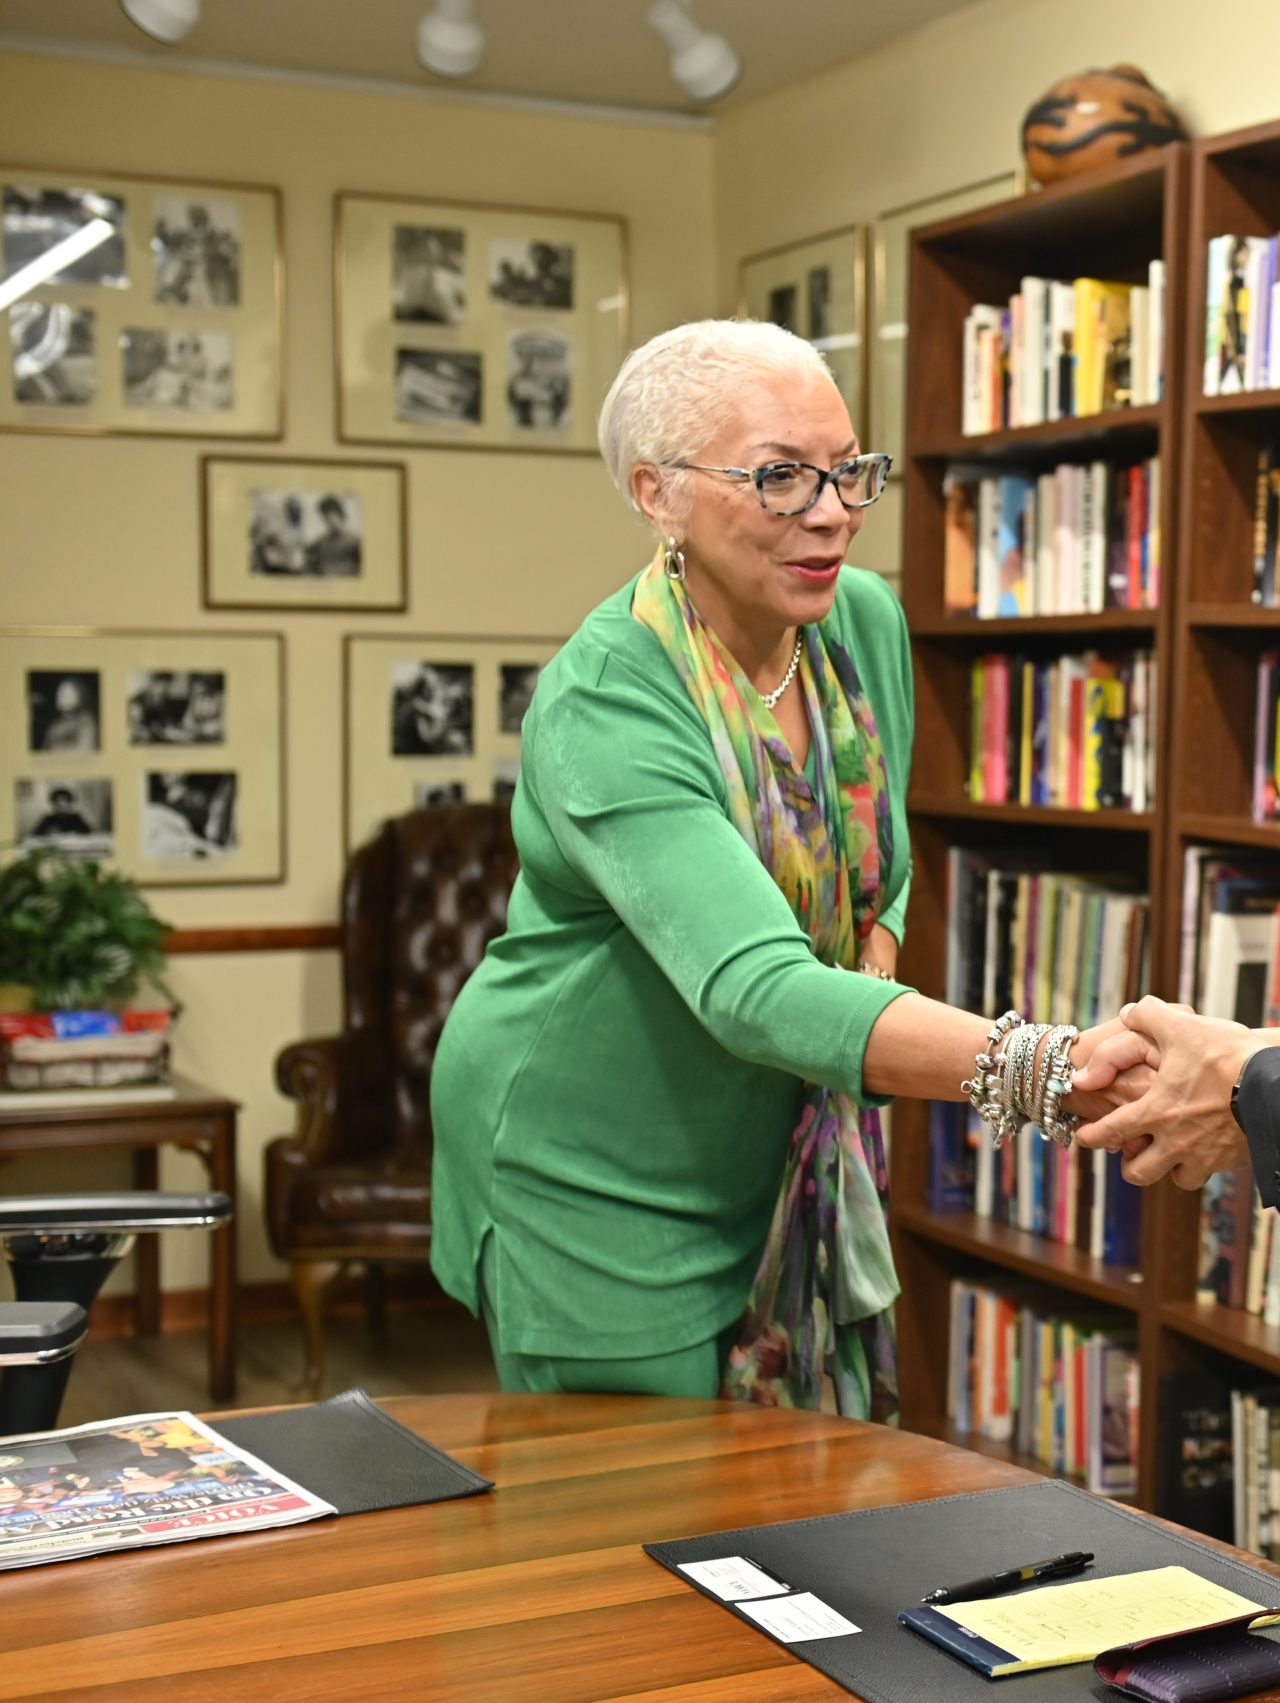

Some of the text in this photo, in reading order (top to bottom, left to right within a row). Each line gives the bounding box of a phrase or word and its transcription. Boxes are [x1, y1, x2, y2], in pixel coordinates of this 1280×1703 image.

[150, 1495, 213, 1514] the
[216, 1485, 274, 1504] On
[45, 1506, 147, 1531] Road
[167, 1502, 280, 1529] VOICE
